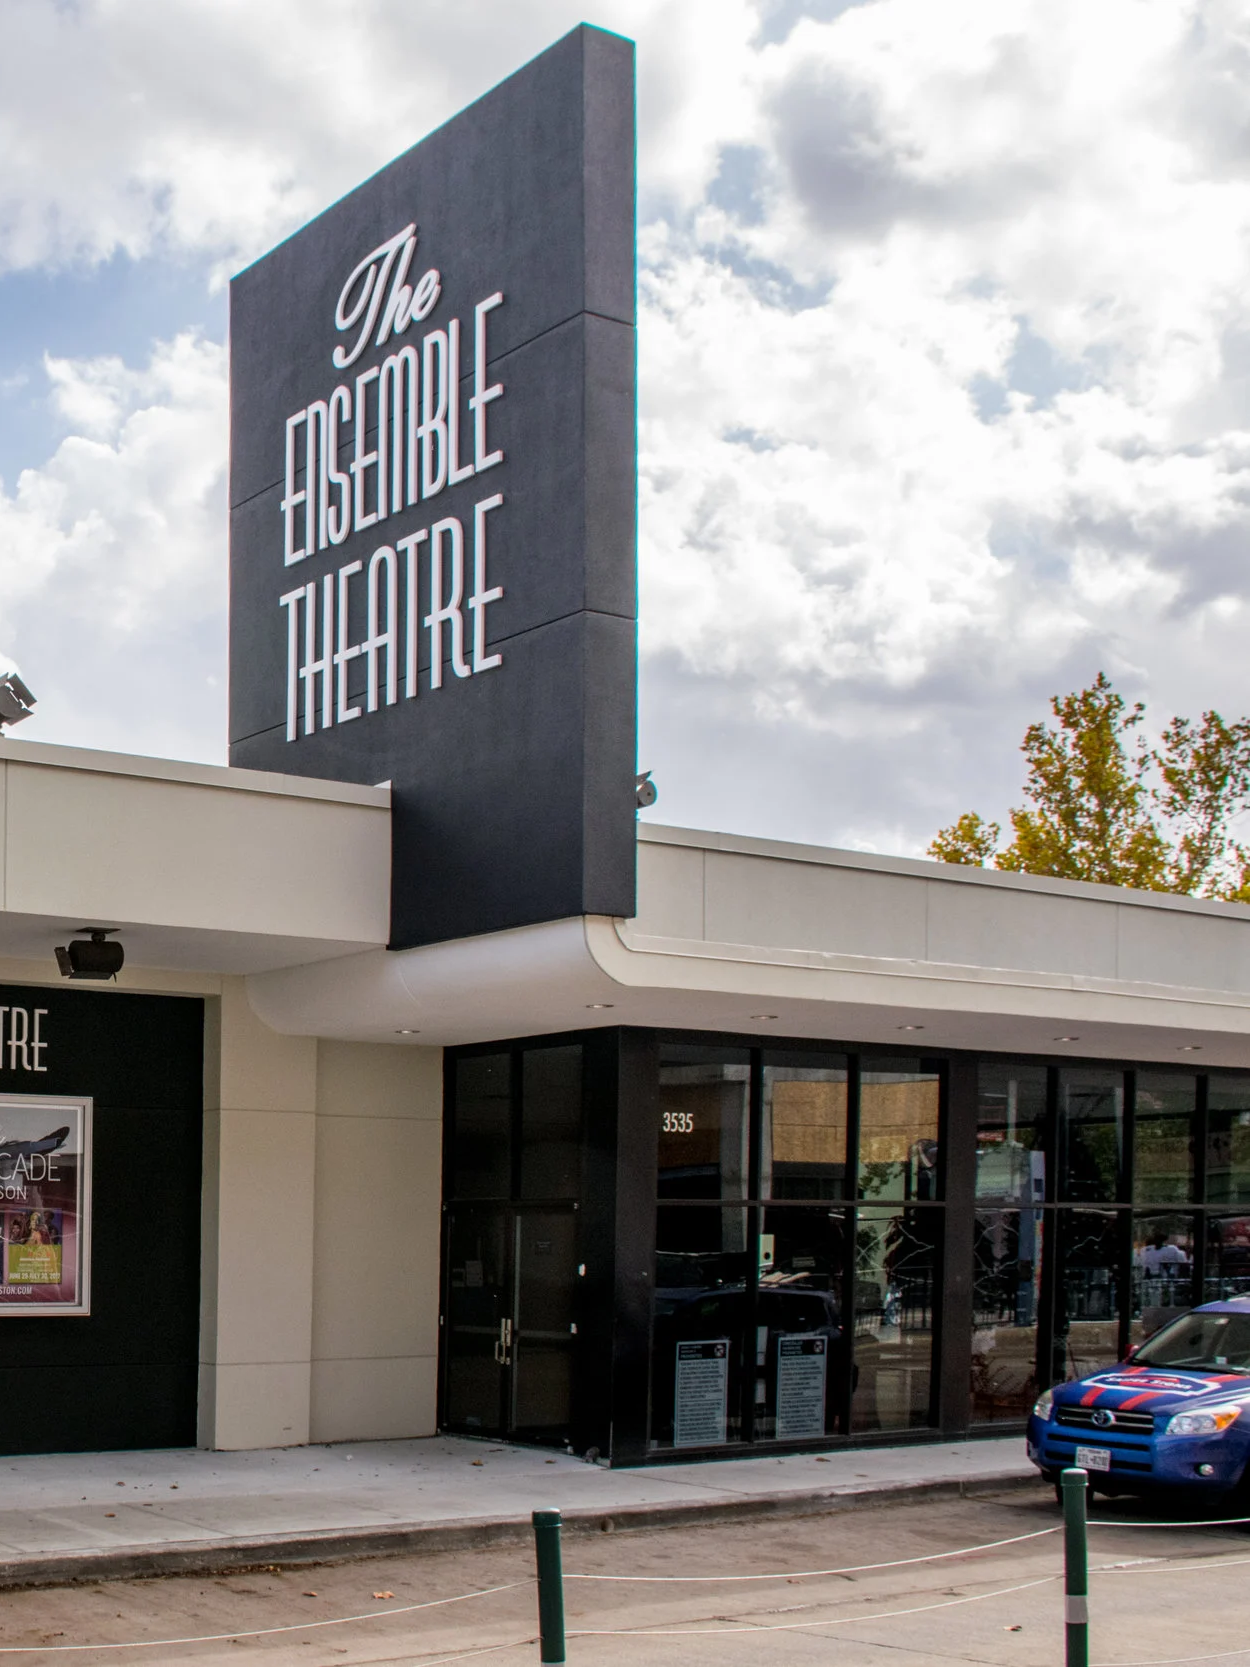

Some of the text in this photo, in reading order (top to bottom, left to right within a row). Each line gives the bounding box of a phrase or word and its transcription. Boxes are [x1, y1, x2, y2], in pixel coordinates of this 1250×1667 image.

[332, 223, 442, 369] The
[280, 292, 504, 568] ENSEMBLE
[279, 493, 504, 743] THEATRE
[662, 1111, 694, 1134] 3535
